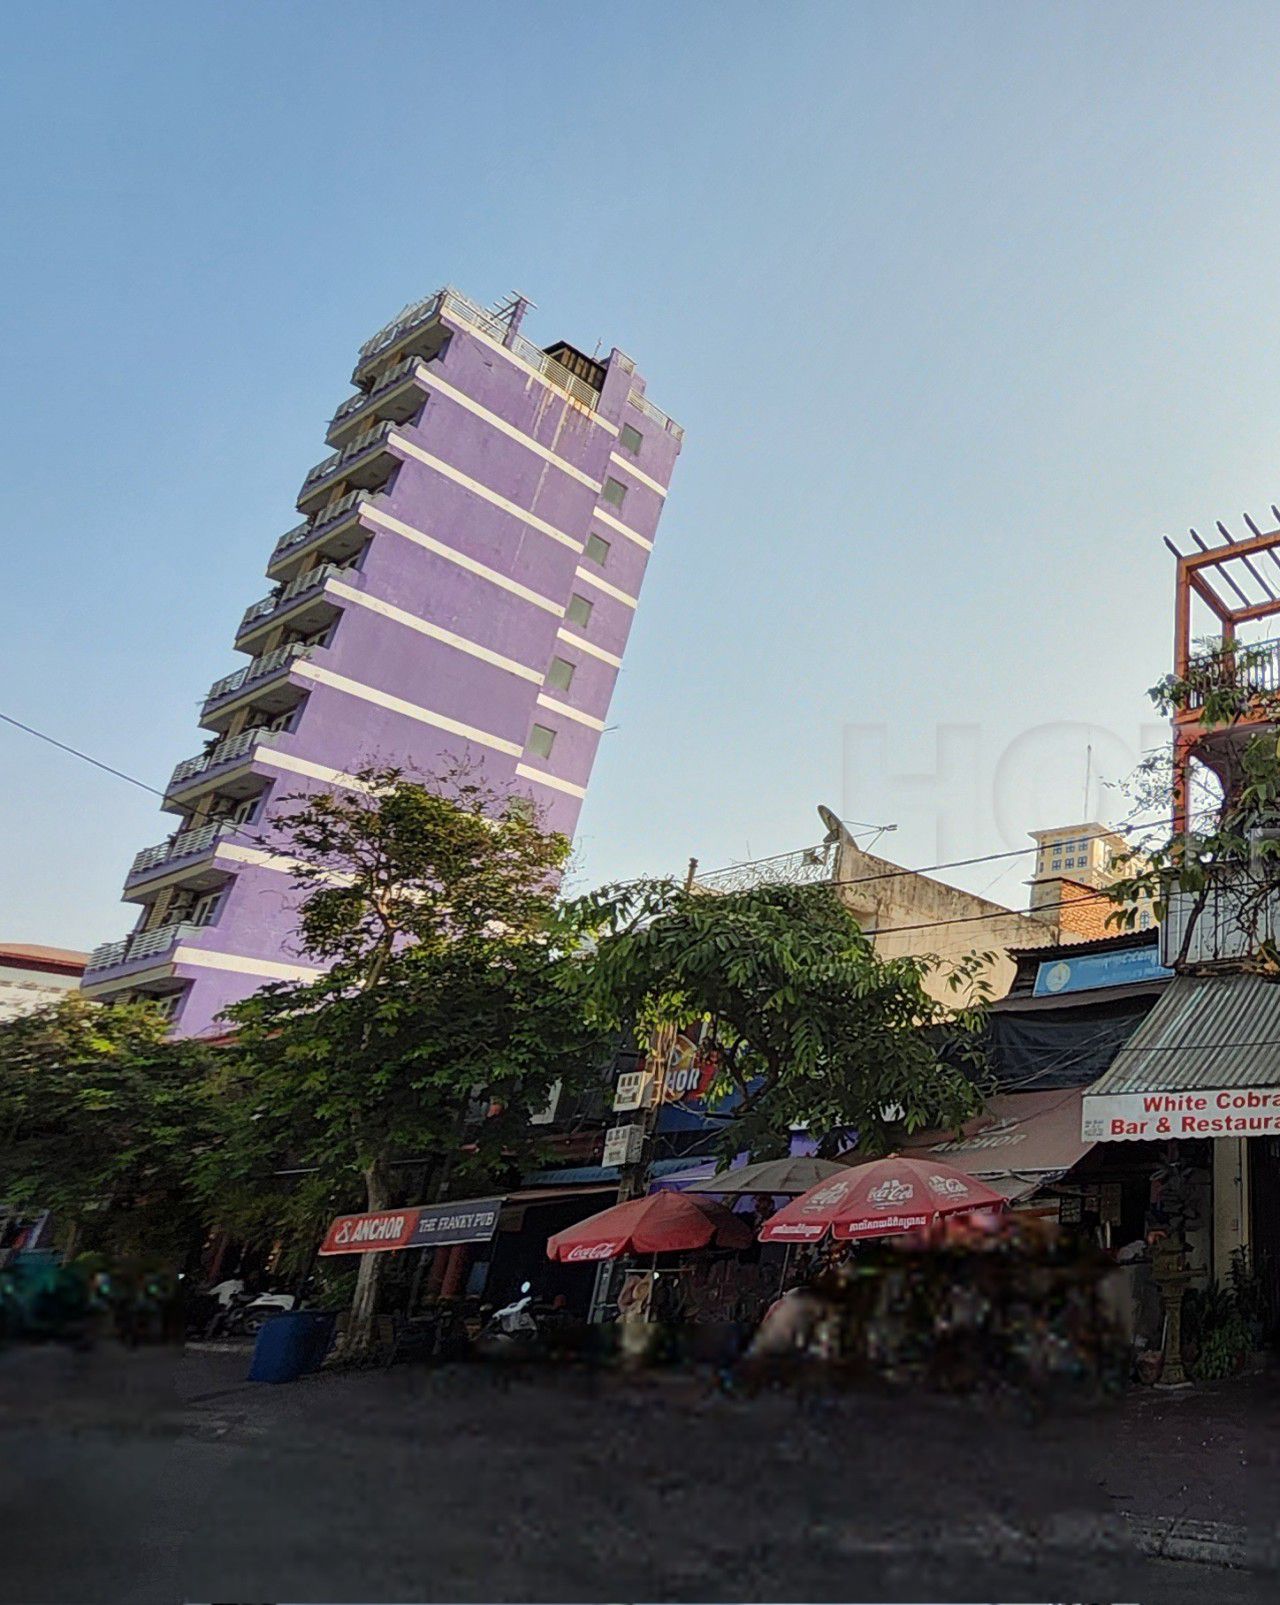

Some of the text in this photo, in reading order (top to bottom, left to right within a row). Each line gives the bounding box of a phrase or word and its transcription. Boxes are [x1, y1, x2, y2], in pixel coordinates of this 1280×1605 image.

[1143, 1094, 1208, 1113] White
[1110, 1119, 1148, 1136] Bar
[1156, 1117, 1172, 1134] &
[351, 1216, 405, 1242] ANCHOR
[418, 1218, 438, 1233] THE
[473, 1211, 495, 1228] PUB
